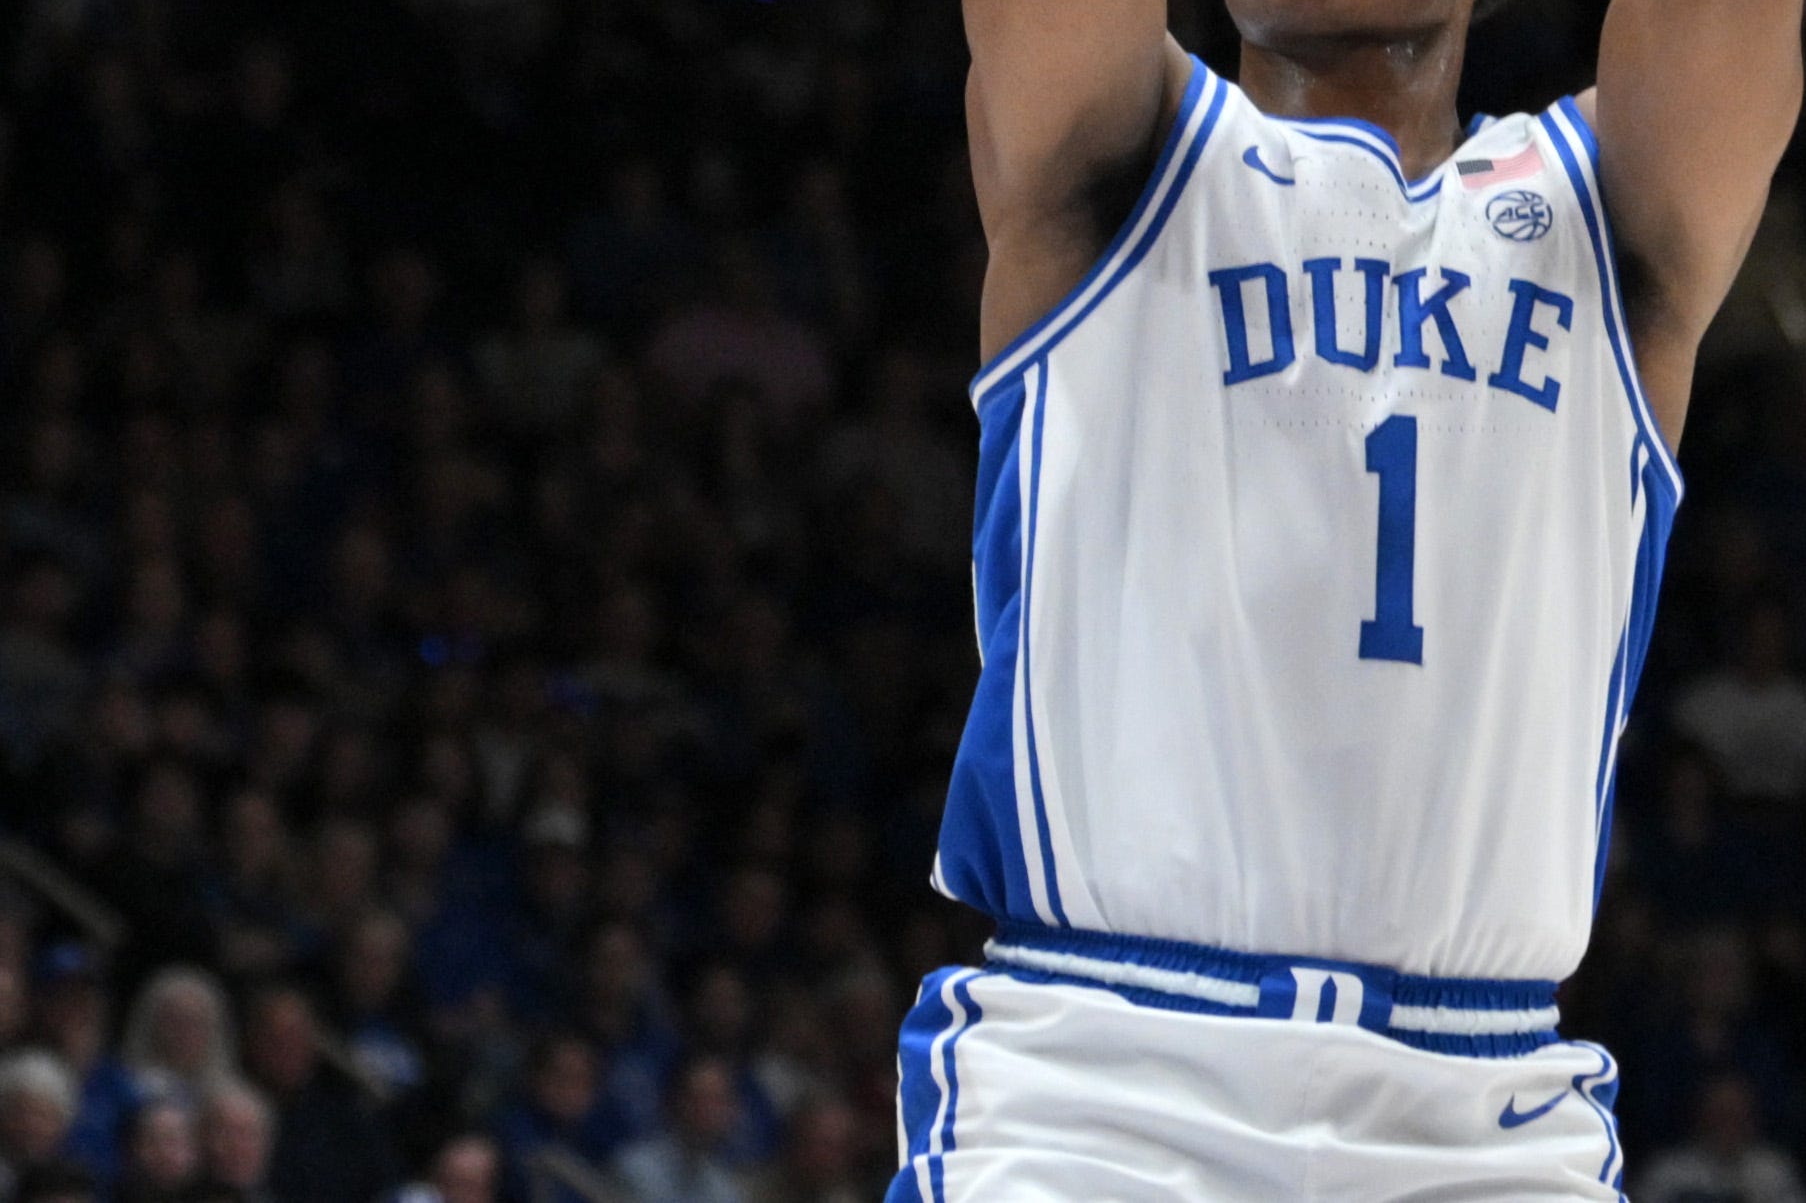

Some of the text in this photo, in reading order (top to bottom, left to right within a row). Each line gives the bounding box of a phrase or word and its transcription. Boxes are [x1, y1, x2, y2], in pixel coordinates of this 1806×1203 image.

[1495, 203, 1545, 222] ACC
[1208, 257, 1573, 413] DUKE
[1358, 414, 1424, 666] 1
